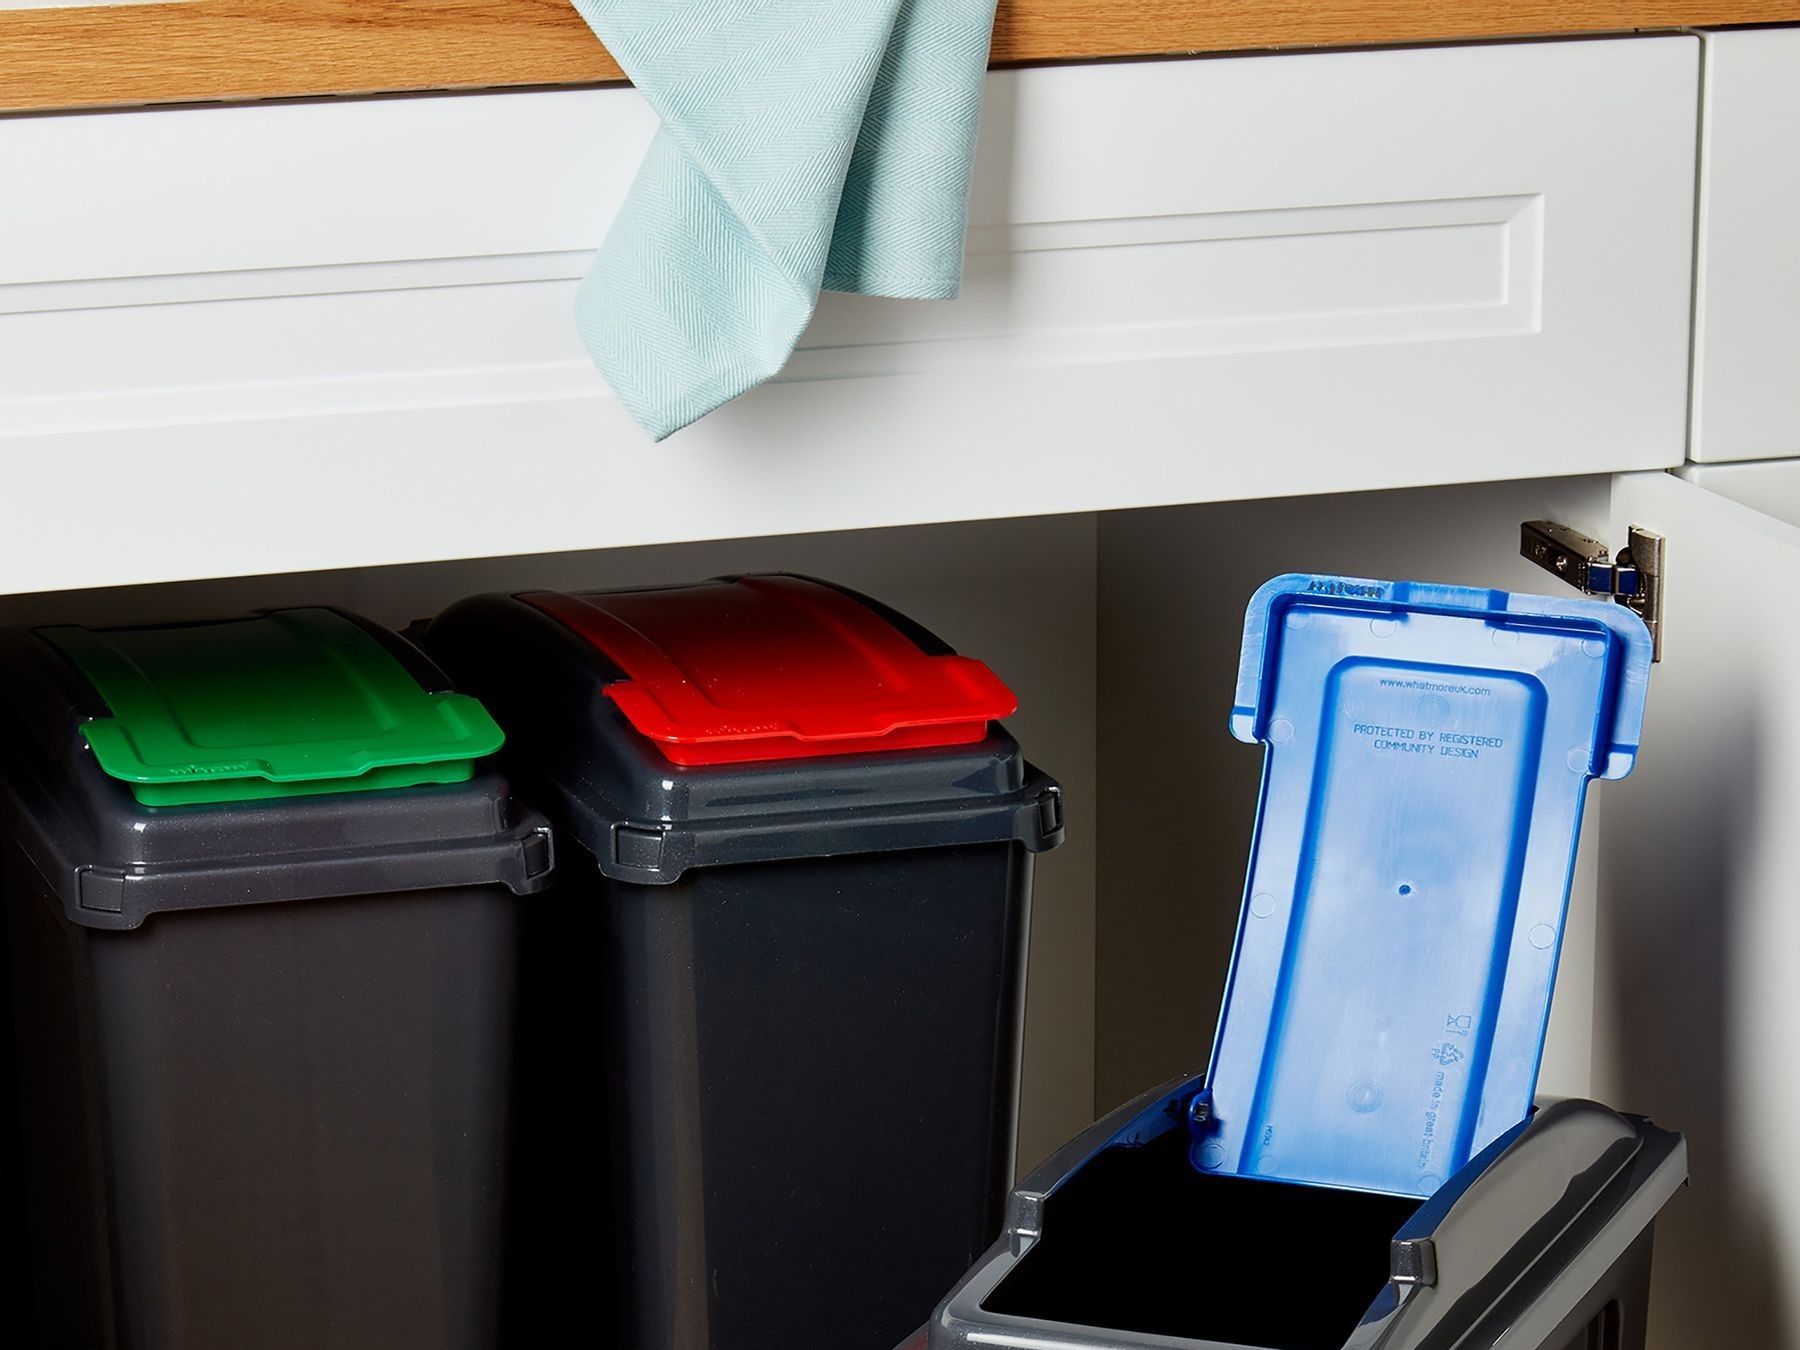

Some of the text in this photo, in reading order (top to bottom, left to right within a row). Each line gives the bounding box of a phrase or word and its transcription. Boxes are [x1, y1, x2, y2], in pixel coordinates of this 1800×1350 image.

[1380, 678, 1491, 696] www.whatmoreuk.com
[1353, 723, 1503, 748] PROTECTED BY REGISTERED
[1374, 739, 1480, 759] COMMUNITY DESIGN
[1432, 1072, 1445, 1098] made
[1424, 1112, 1437, 1137] great
